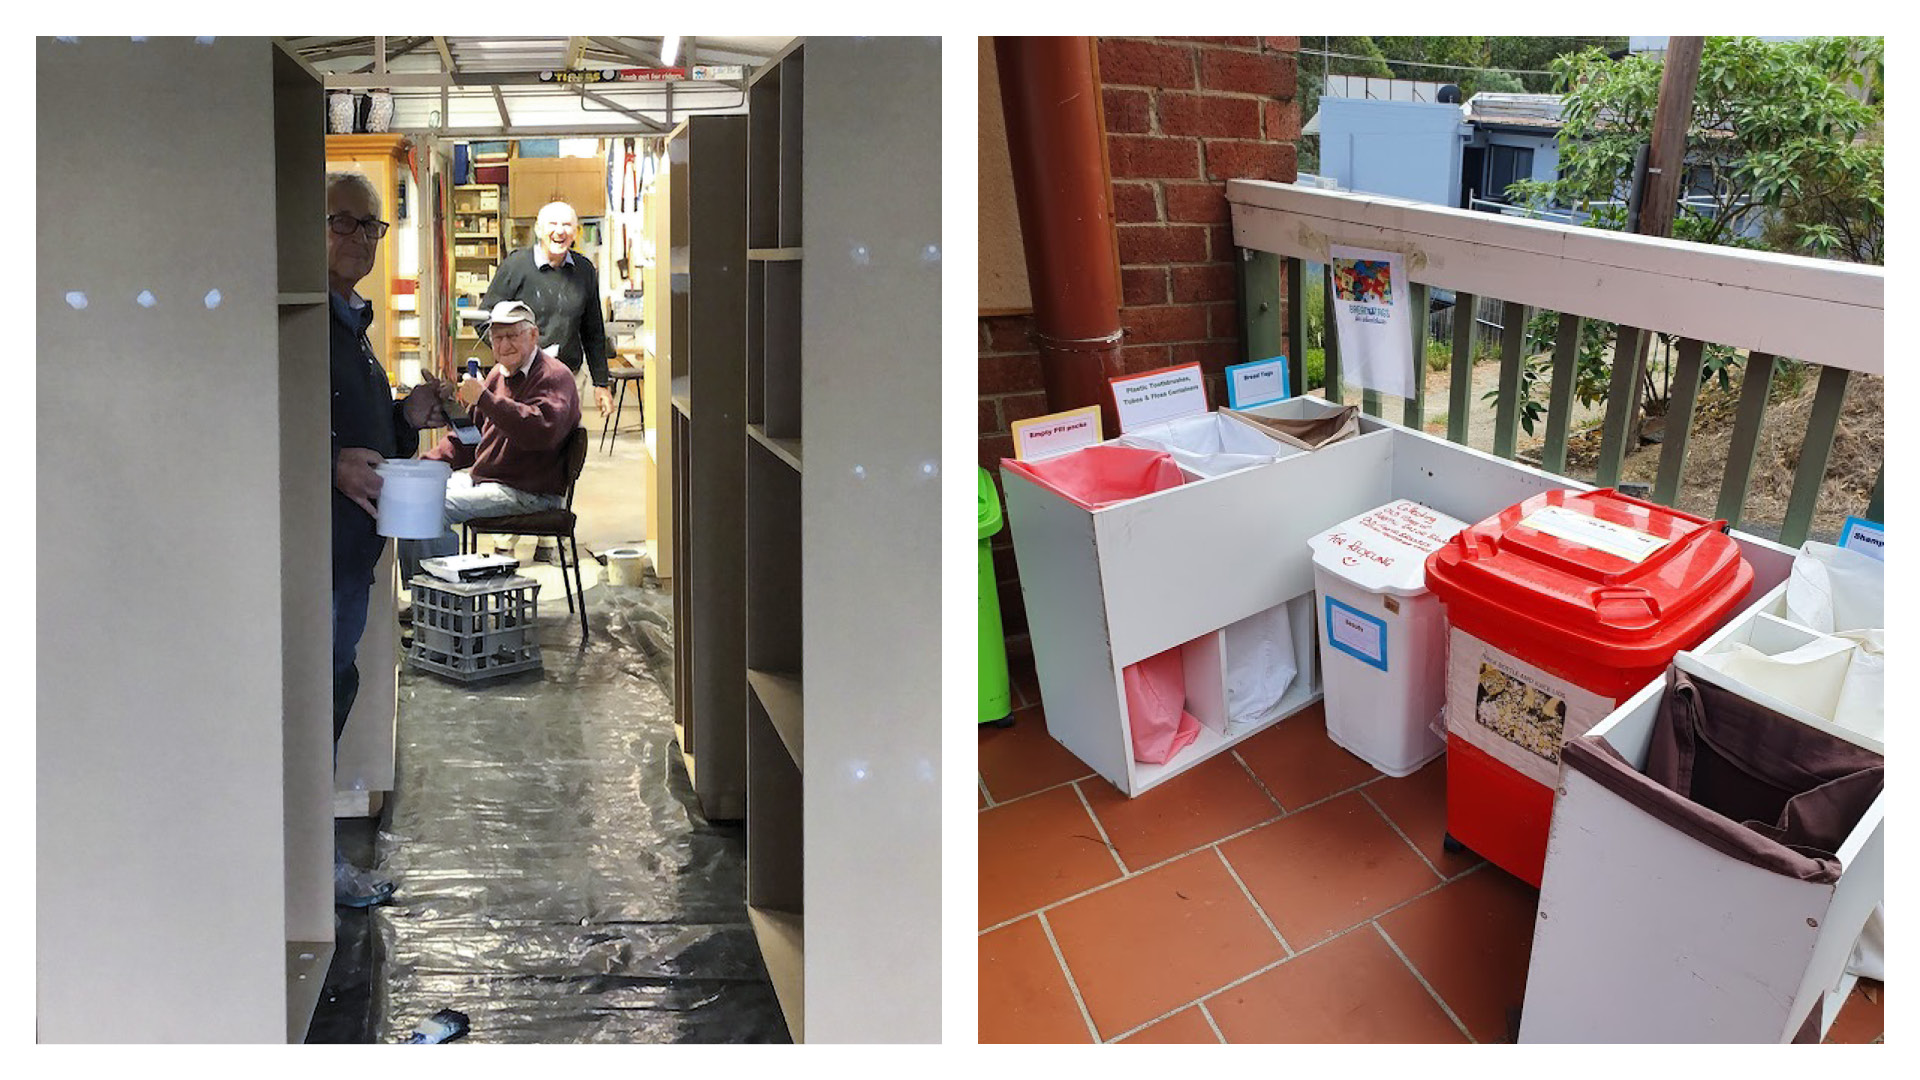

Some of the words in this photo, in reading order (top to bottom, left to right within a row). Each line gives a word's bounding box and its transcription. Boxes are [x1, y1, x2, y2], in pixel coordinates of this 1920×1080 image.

[1244, 373, 1259, 381] Bread
[1123, 397, 1143, 405] Tubes
[1168, 385, 1199, 395] Containers
[1126, 385, 1148, 394] Plastic
[1030, 430, 1052, 438] Empty
[1067, 422, 1087, 431] packs
[1499, 662, 1519, 677] BOTTLE
[1520, 673, 1534, 683] AND
